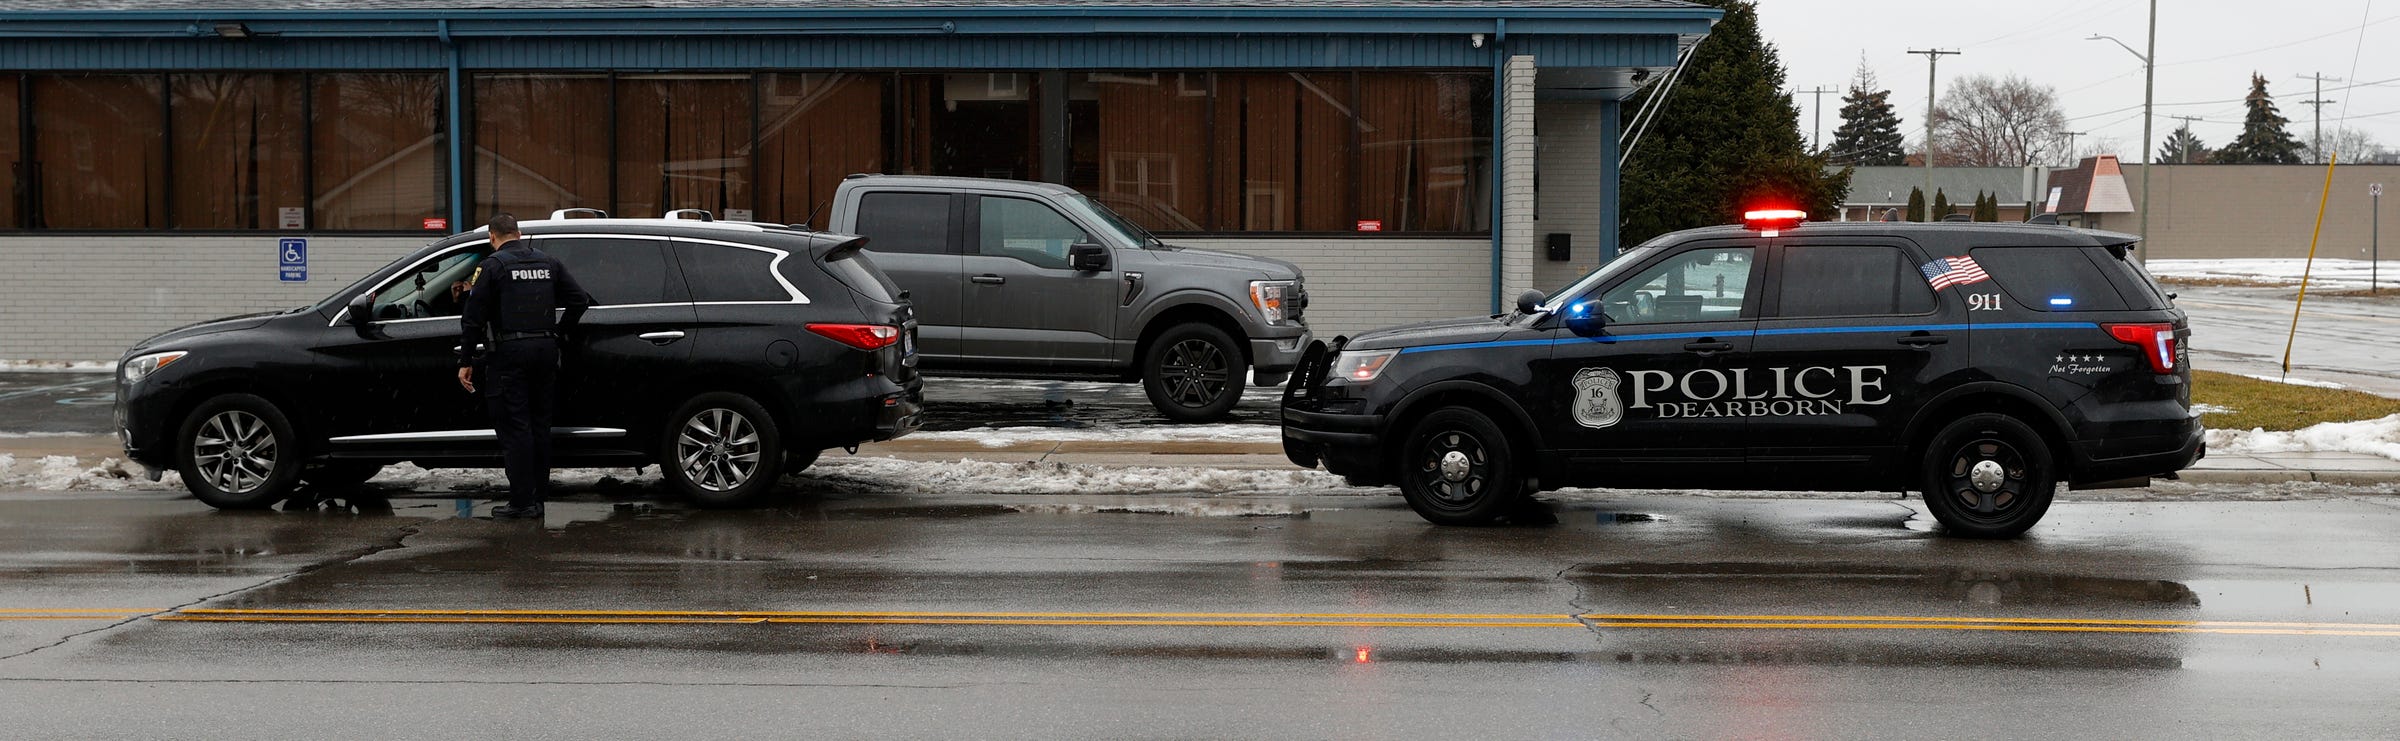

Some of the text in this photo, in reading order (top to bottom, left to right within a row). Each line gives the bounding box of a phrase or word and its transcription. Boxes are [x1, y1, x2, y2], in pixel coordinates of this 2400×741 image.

[511, 269, 551, 280] POLICE
[1968, 293, 2003, 311] 911
[2048, 363, 2111, 375] Not Forgotten
[1591, 388, 1603, 398] 16
[1625, 365, 1892, 409] POLICE
[1656, 399, 1843, 418] DEARBORN
